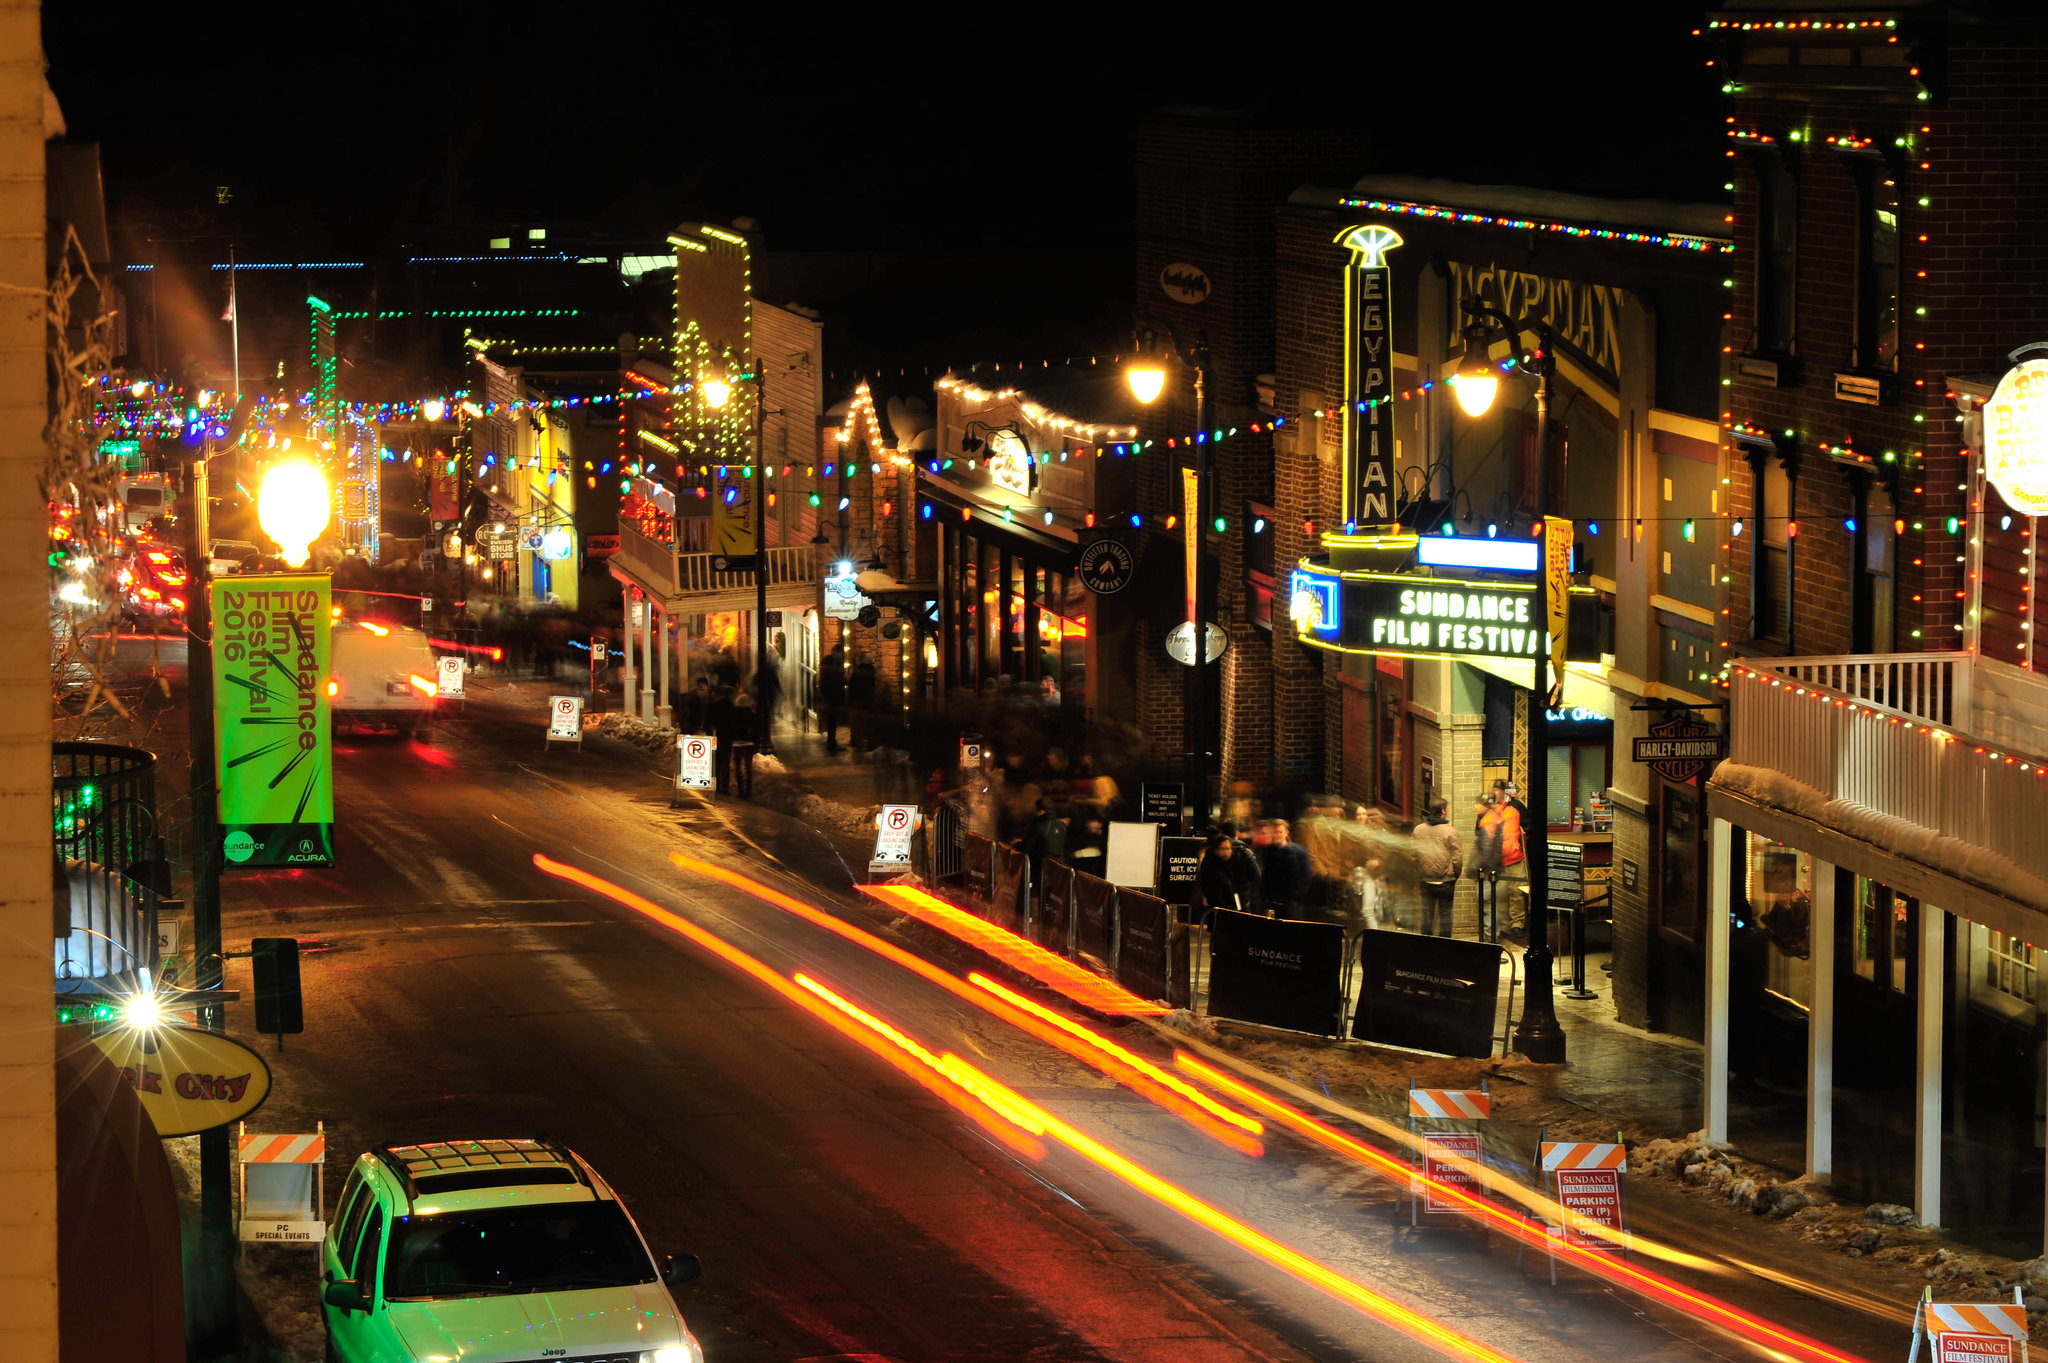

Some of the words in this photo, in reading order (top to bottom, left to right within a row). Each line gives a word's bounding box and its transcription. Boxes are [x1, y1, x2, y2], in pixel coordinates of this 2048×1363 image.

[1362, 273, 1389, 520] EGYPTIAN
[1090, 577, 1124, 590] COMPANY
[1400, 590, 1530, 623] SUNDANCE
[223, 590, 246, 662] 2016
[271, 591, 294, 655] Film
[1373, 618, 1430, 647] FILM
[247, 591, 271, 713] Festival
[296, 590, 319, 751] Sundance
[1659, 727, 1700, 738] MOTOR
[1640, 741, 1718, 757] HARLEY-DAVIDSON
[1657, 760, 1700, 778] CYCLES
[223, 840, 265, 850] sundance
[288, 854, 327, 862] ACURA
[1248, 947, 1303, 963] SUNDANCE
[1395, 969, 1426, 981] SUNDANCE
[1426, 975, 1440, 984] FILM
[175, 1072, 251, 1103] City
[1429, 1141, 1476, 1149] SUNDANCE
[1436, 1164, 1470, 1172] PERMIT
[1433, 1175, 1475, 1183] PARKING
[1563, 1175, 1613, 1184] SUNDANCE
[1566, 1197, 1615, 1205] PARKING
[1572, 1207, 1594, 1215] FOR
[1596, 1207, 1611, 1216] (P)
[1573, 1217, 1612, 1226] PERMIT
[1579, 1228, 1606, 1236] ONLY
[542, 1348, 566, 1356] Jeep
[1946, 1340, 2007, 1353] SUNDANCE
[1947, 1352, 1967, 1361] FILM
[1968, 1354, 2008, 1363] FESTIVAL
